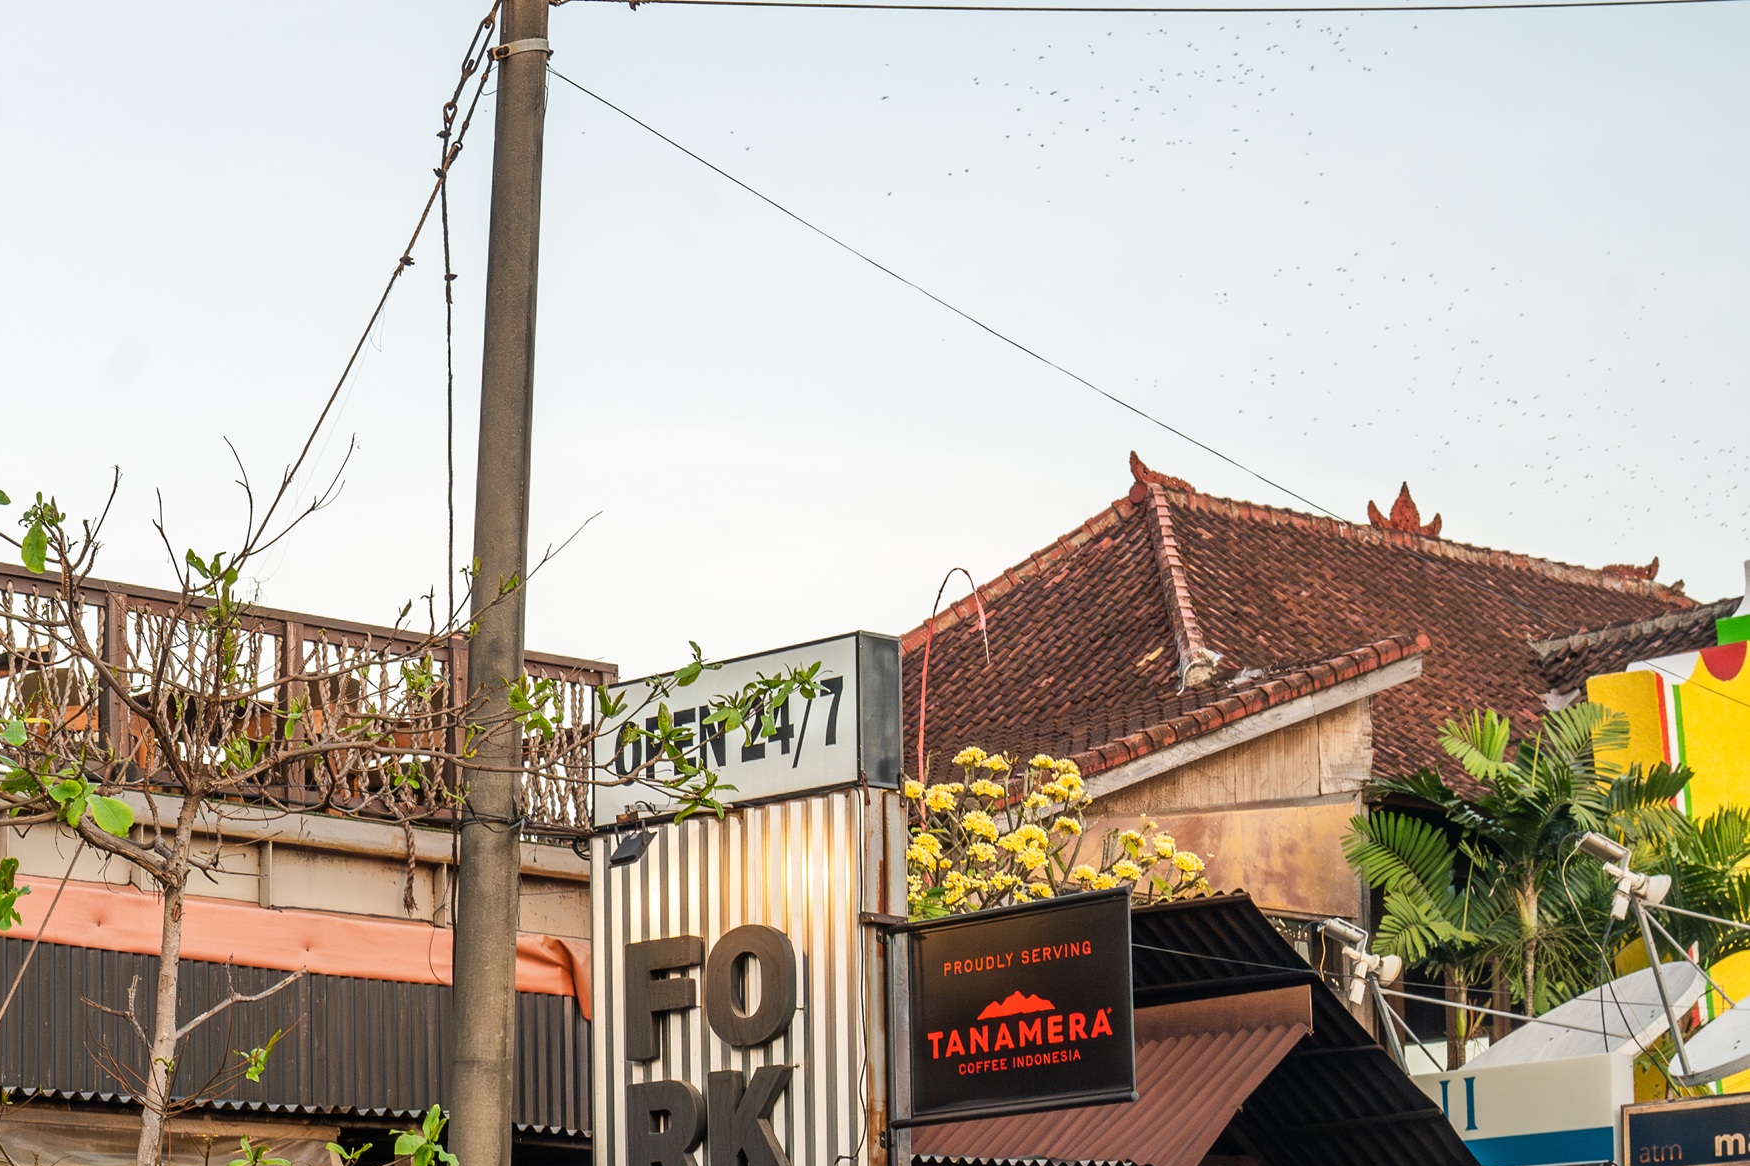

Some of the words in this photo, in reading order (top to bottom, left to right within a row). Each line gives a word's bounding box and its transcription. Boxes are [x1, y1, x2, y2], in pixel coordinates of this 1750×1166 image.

[740, 675, 844, 769] 24/7
[943, 952, 1014, 977] PROUDLY
[1021, 940, 1092, 965] SERVING
[927, 1008, 1113, 1060] TANAMERA
[958, 1058, 1008, 1076] COFFEE
[1012, 1049, 1082, 1069] INDONESIA
[1639, 1143, 1683, 1164] atm
[1714, 1132, 1750, 1157] m
